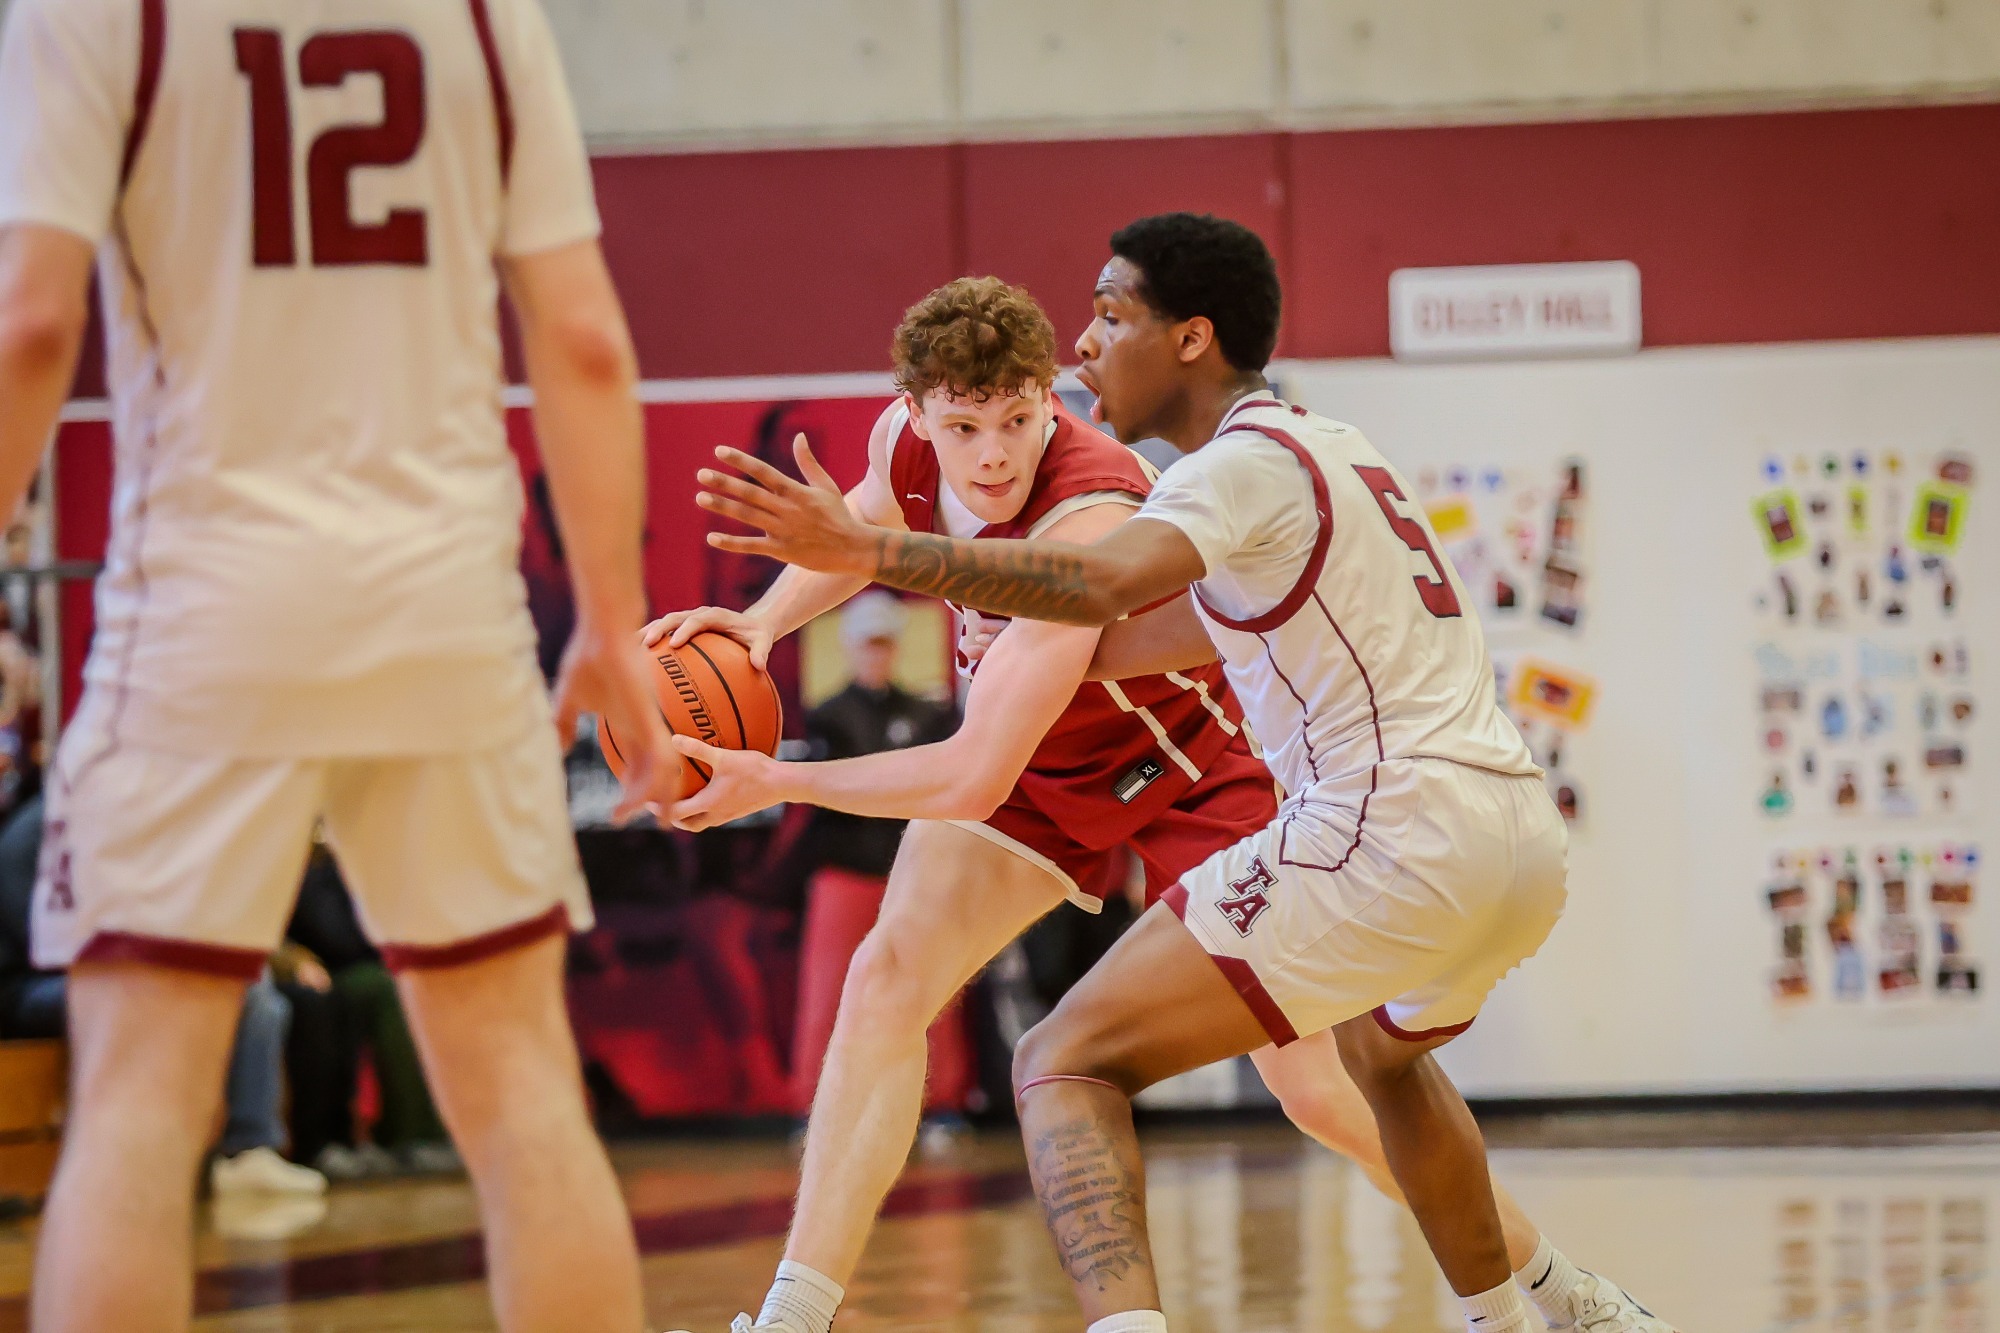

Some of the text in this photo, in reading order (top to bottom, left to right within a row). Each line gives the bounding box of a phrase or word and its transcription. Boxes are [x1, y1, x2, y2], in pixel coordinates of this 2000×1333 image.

[233, 28, 428, 266] 12
[1350, 464, 1462, 618] 5
[1141, 764, 1158, 777] XL
